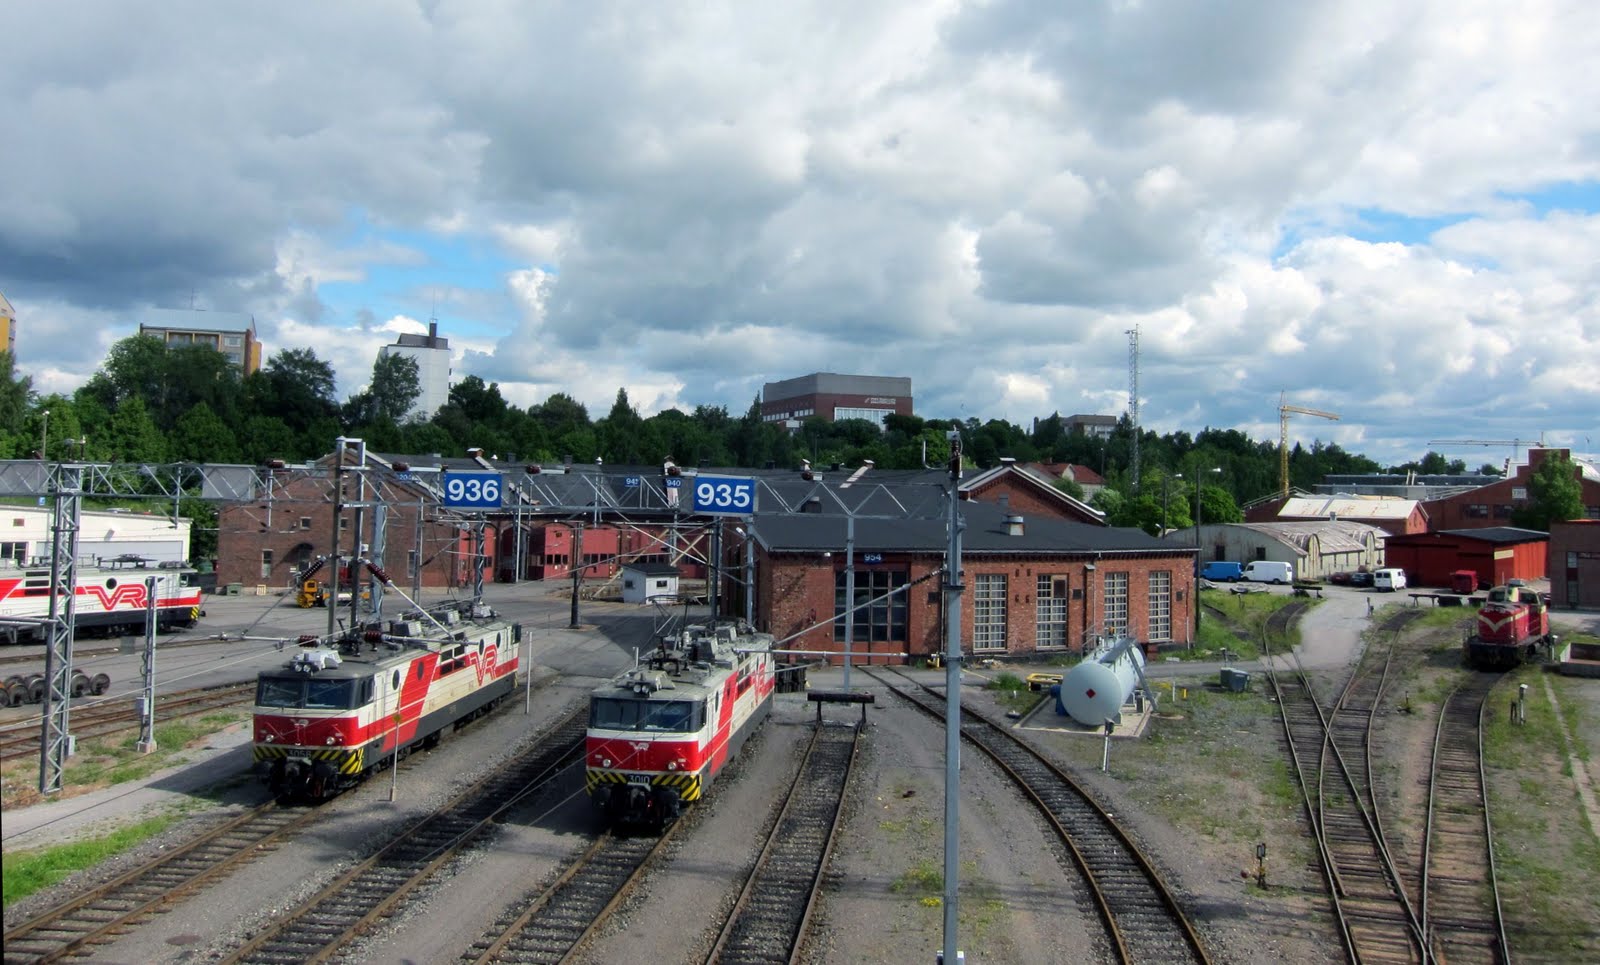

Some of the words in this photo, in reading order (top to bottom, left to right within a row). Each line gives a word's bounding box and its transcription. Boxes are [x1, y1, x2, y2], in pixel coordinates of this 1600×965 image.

[448, 478, 499, 502] 936
[666, 479, 681, 487] 940
[697, 483, 750, 508] 935
[864, 553, 882, 561] 954
[84, 583, 148, 611] VR
[468, 644, 498, 687] VR
[628, 741, 650, 752] VR
